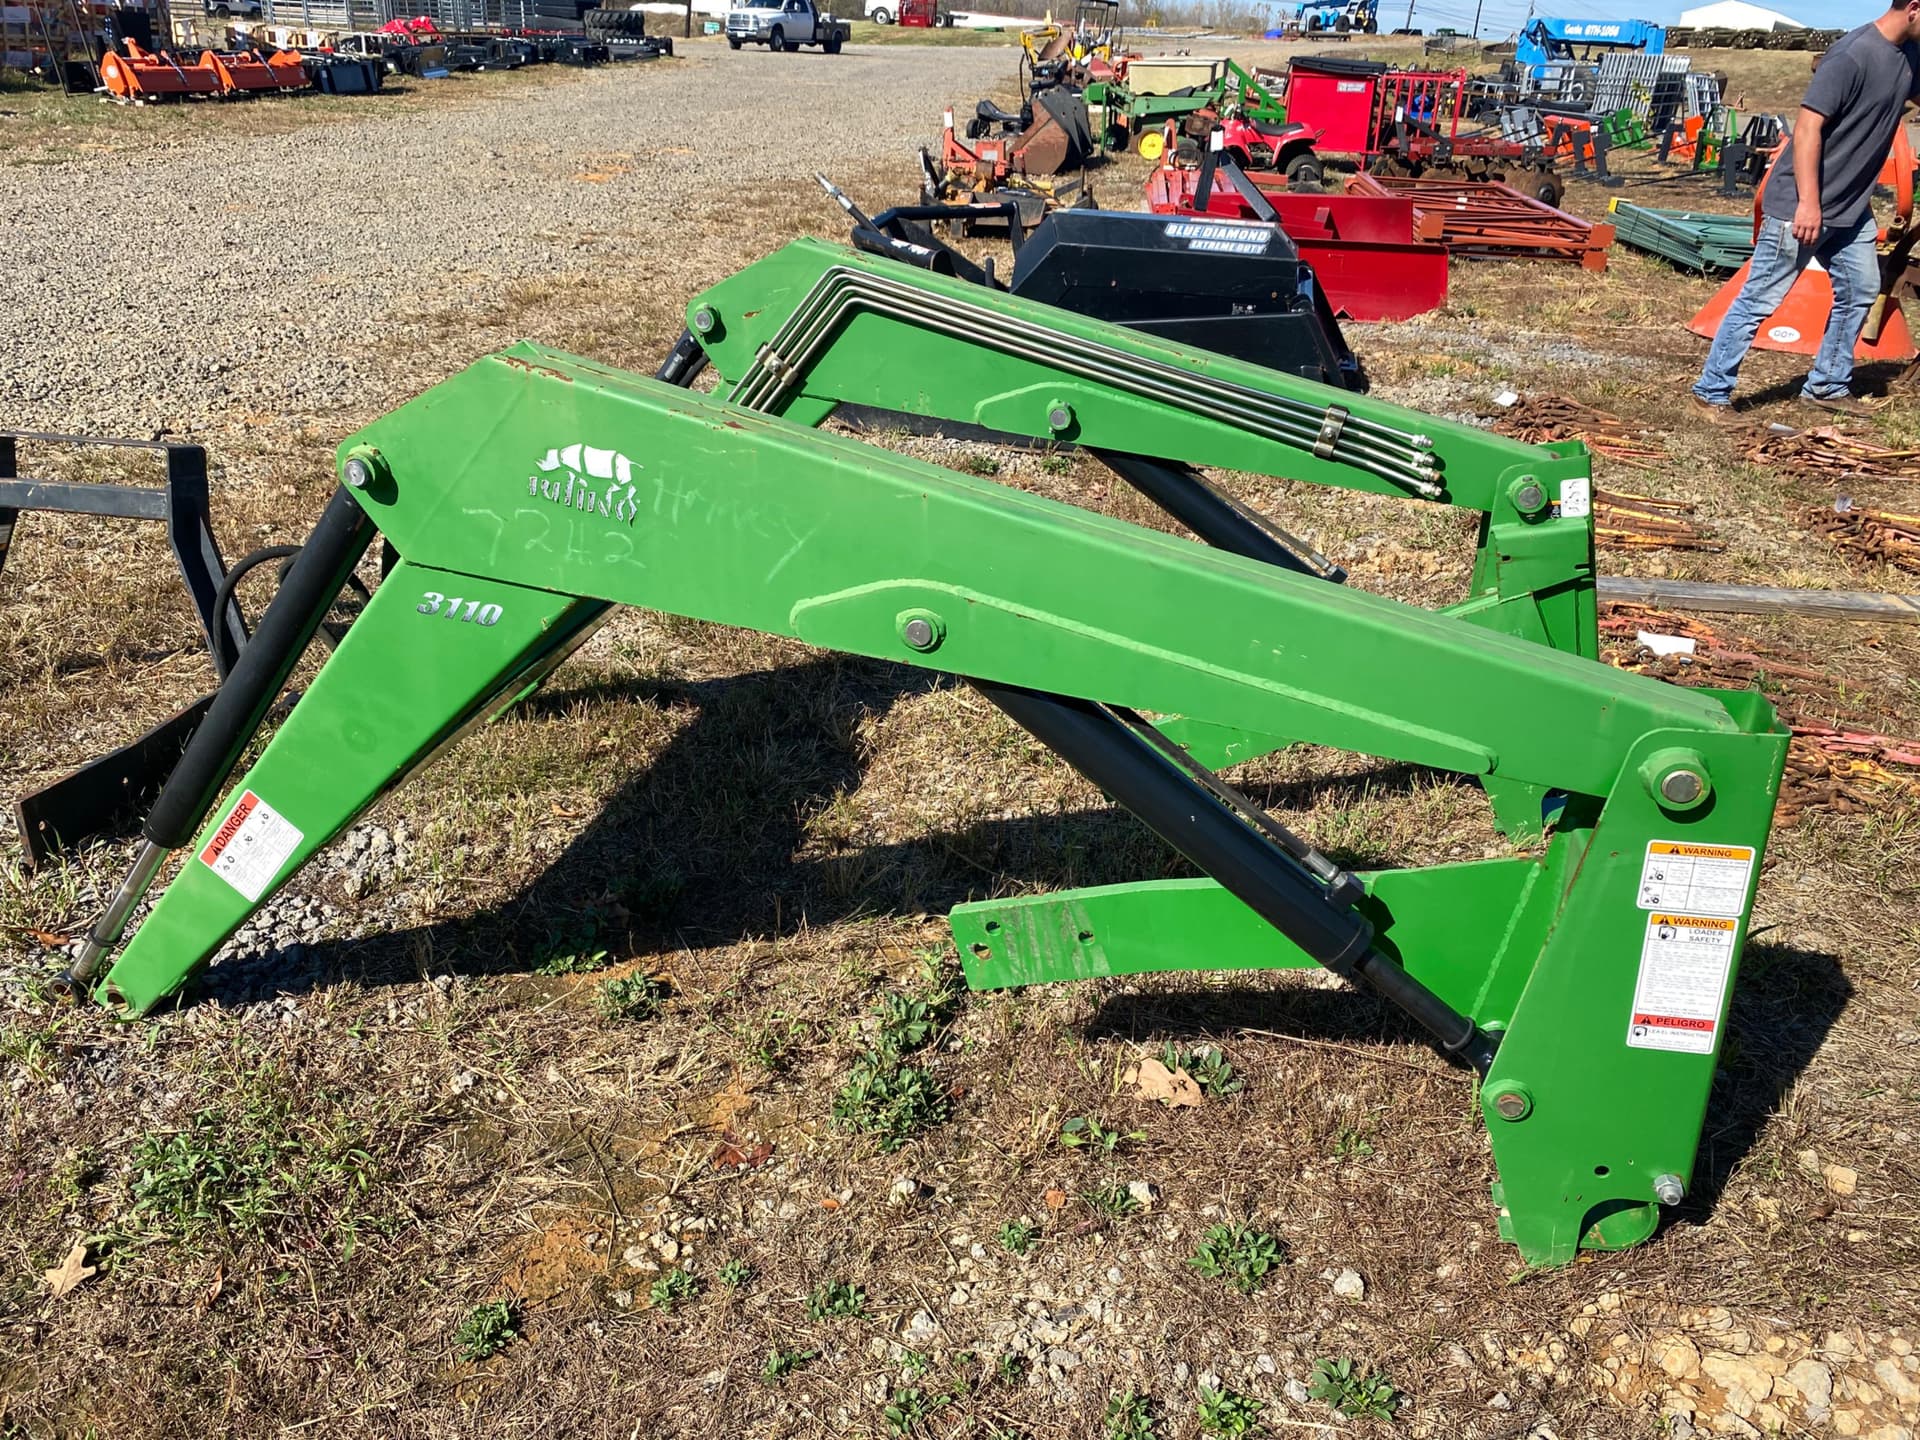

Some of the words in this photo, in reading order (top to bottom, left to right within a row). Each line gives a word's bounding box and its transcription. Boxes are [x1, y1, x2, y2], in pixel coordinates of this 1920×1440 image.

[1166, 223, 1201, 238] BLUE
[1201, 226, 1270, 242] DIAMOND
[1190, 240, 1237, 252] EXTREME
[1239, 243, 1267, 254] DUTY
[417, 592, 503, 627] 3110
[216, 803, 251, 849] DANGER
[1684, 847, 1731, 857] WARNING
[1673, 917, 1727, 928] WARNING
[1656, 1017, 1705, 1028] PELIGRO
